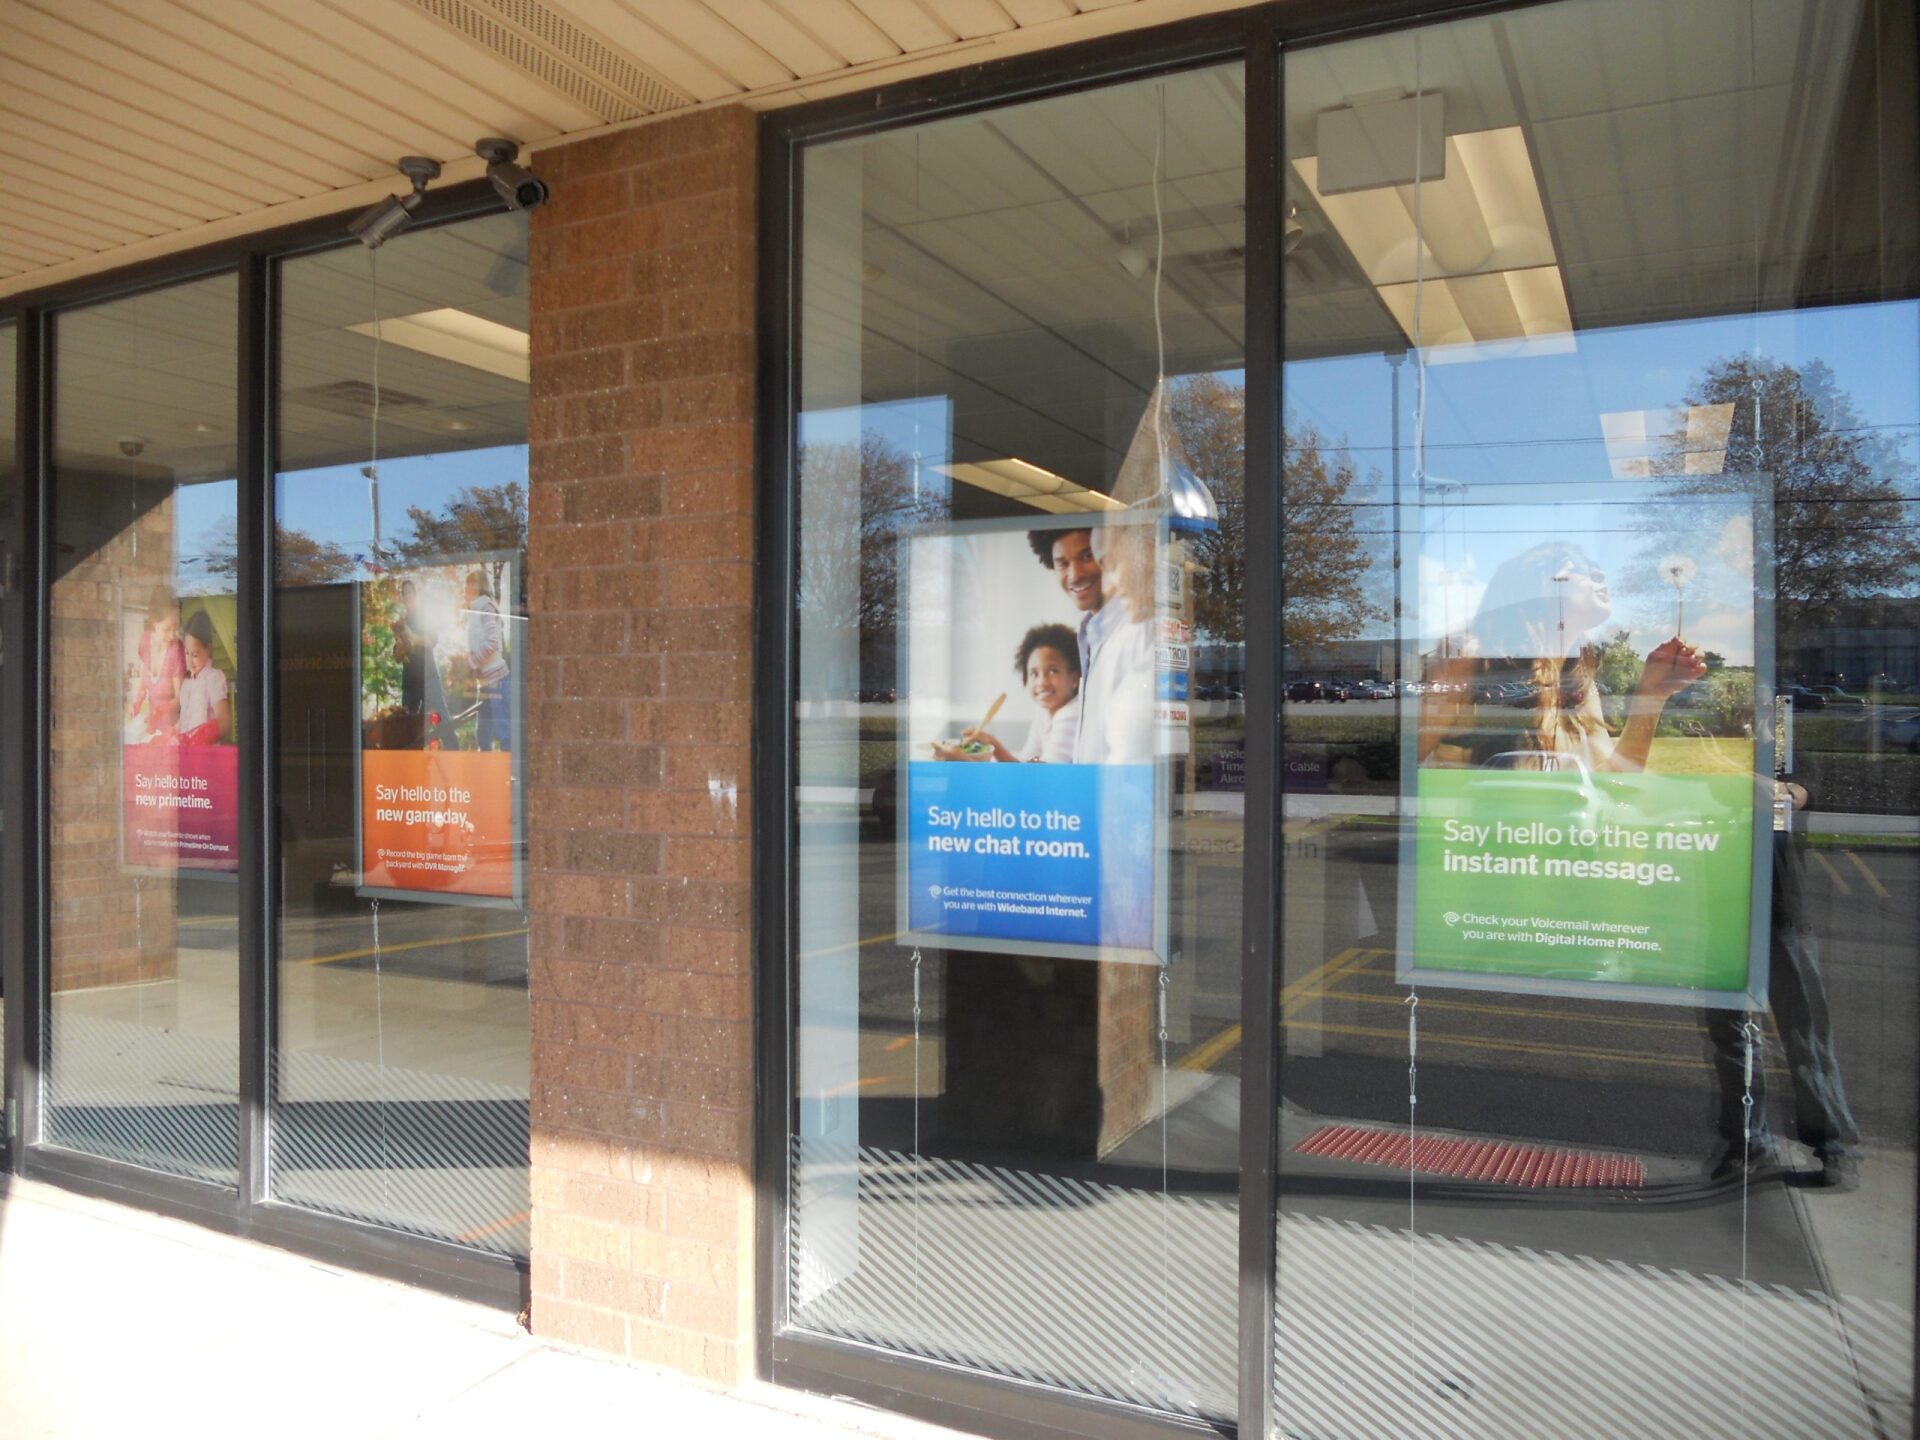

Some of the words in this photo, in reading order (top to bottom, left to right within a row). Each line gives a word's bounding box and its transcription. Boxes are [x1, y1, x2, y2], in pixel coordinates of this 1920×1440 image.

[1290, 761, 1320, 772] Cable
[136, 774, 153, 789] Say
[155, 775, 178, 788] hello
[180, 777, 189, 789] to
[191, 776, 208, 790] the
[136, 795, 159, 806] new
[159, 794, 213, 809] primetime.
[376, 784, 398, 803] Say
[401, 785, 431, 802] hello
[434, 788, 447, 803] to
[449, 787, 471, 803] the
[376, 808, 403, 821] new
[928, 805, 962, 829] Say
[966, 807, 1016, 829] hello
[1020, 810, 1041, 830] to
[1045, 810, 1081, 831] the
[1444, 819, 1490, 847] Say
[1496, 821, 1562, 846] hello
[1568, 825, 1597, 847] to
[1603, 824, 1649, 848] the
[1656, 831, 1719, 852] new
[928, 835, 971, 853] new
[974, 834, 1020, 856] chat
[1025, 839, 1090, 859] room.
[1443, 849, 1538, 876] instant
[1545, 857, 1681, 886] message.
[943, 886, 959, 897] Get
[960, 887, 975, 898] the
[975, 888, 995, 899] best
[996, 889, 1047, 902] connection
[1049, 891, 1092, 904] wherever
[943, 901, 960, 912] you
[961, 902, 976, 911] are
[977, 901, 996, 912] with
[997, 902, 1045, 916] Wideband
[1046, 906, 1087, 918] Internet.
[1462, 912, 1499, 926] Check
[1501, 917, 1529, 930] your
[1530, 916, 1589, 932] Voicemail
[1591, 920, 1649, 935] wherever
[1462, 929, 1485, 941] you
[1486, 930, 1506, 941] are
[1507, 930, 1533, 943] with
[1535, 932, 1575, 947] Digital
[1577, 935, 1615, 948] Home
[1617, 937, 1662, 952] Phone.
